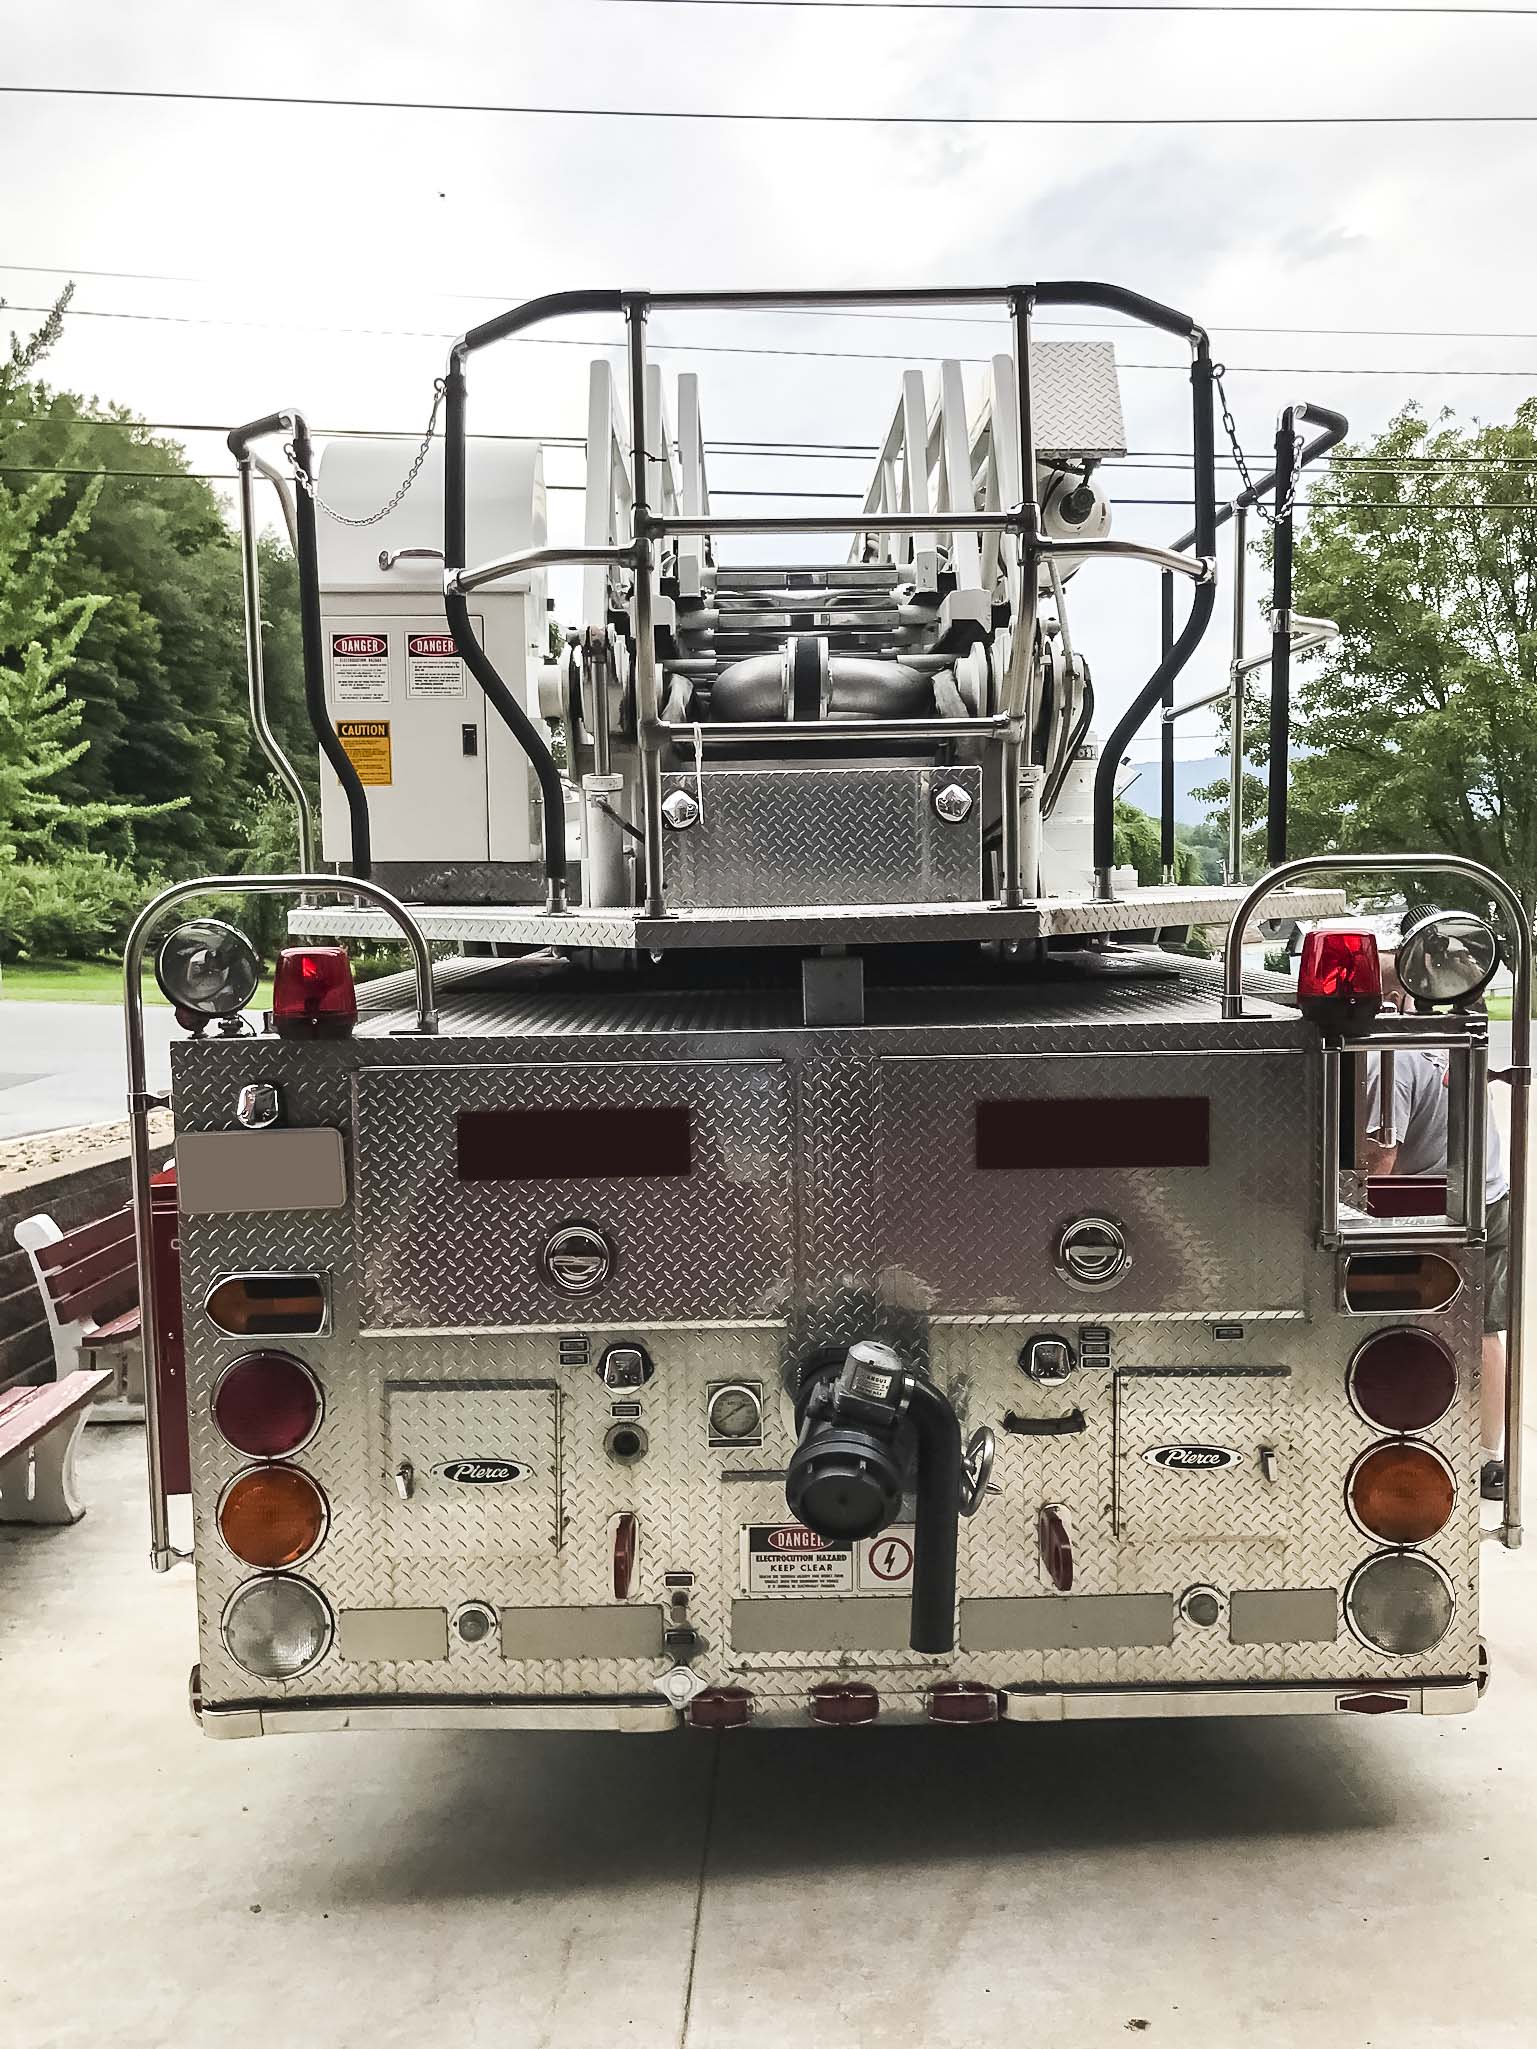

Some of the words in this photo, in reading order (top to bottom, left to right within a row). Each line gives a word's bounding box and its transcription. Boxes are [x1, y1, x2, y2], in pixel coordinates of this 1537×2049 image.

[341, 639, 379, 652] DANGER
[416, 639, 454, 652] DANGER
[341, 724, 385, 736] CAUTION
[1164, 1448, 1221, 1466] Pierce
[453, 1463, 510, 1481] Pierce
[755, 1554, 814, 1563] ELECTROCUTION
[816, 1554, 848, 1562] HAZARD
[770, 1564, 796, 1572] KEEP
[799, 1564, 833, 1572] CLEAR
